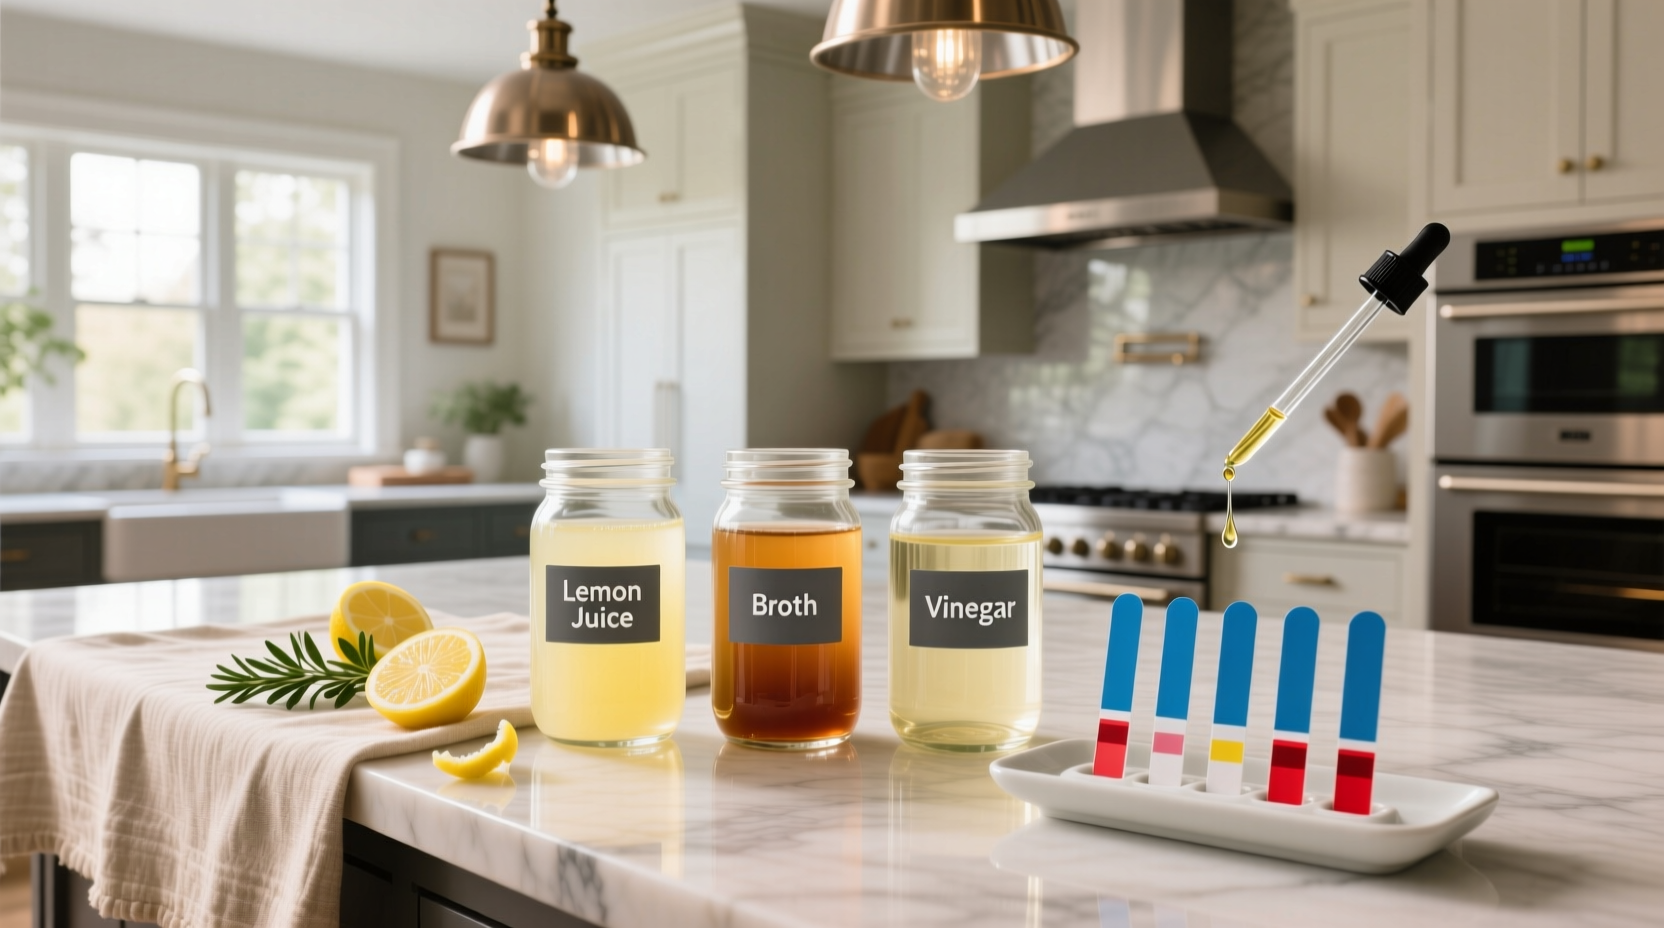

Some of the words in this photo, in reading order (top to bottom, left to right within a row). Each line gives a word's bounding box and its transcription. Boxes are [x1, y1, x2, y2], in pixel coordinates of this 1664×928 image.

[563, 579, 642, 602] Lemon
[752, 593, 818, 617] Broth
[925, 595, 1017, 627] Vinegar
[571, 606, 634, 629] Juice
